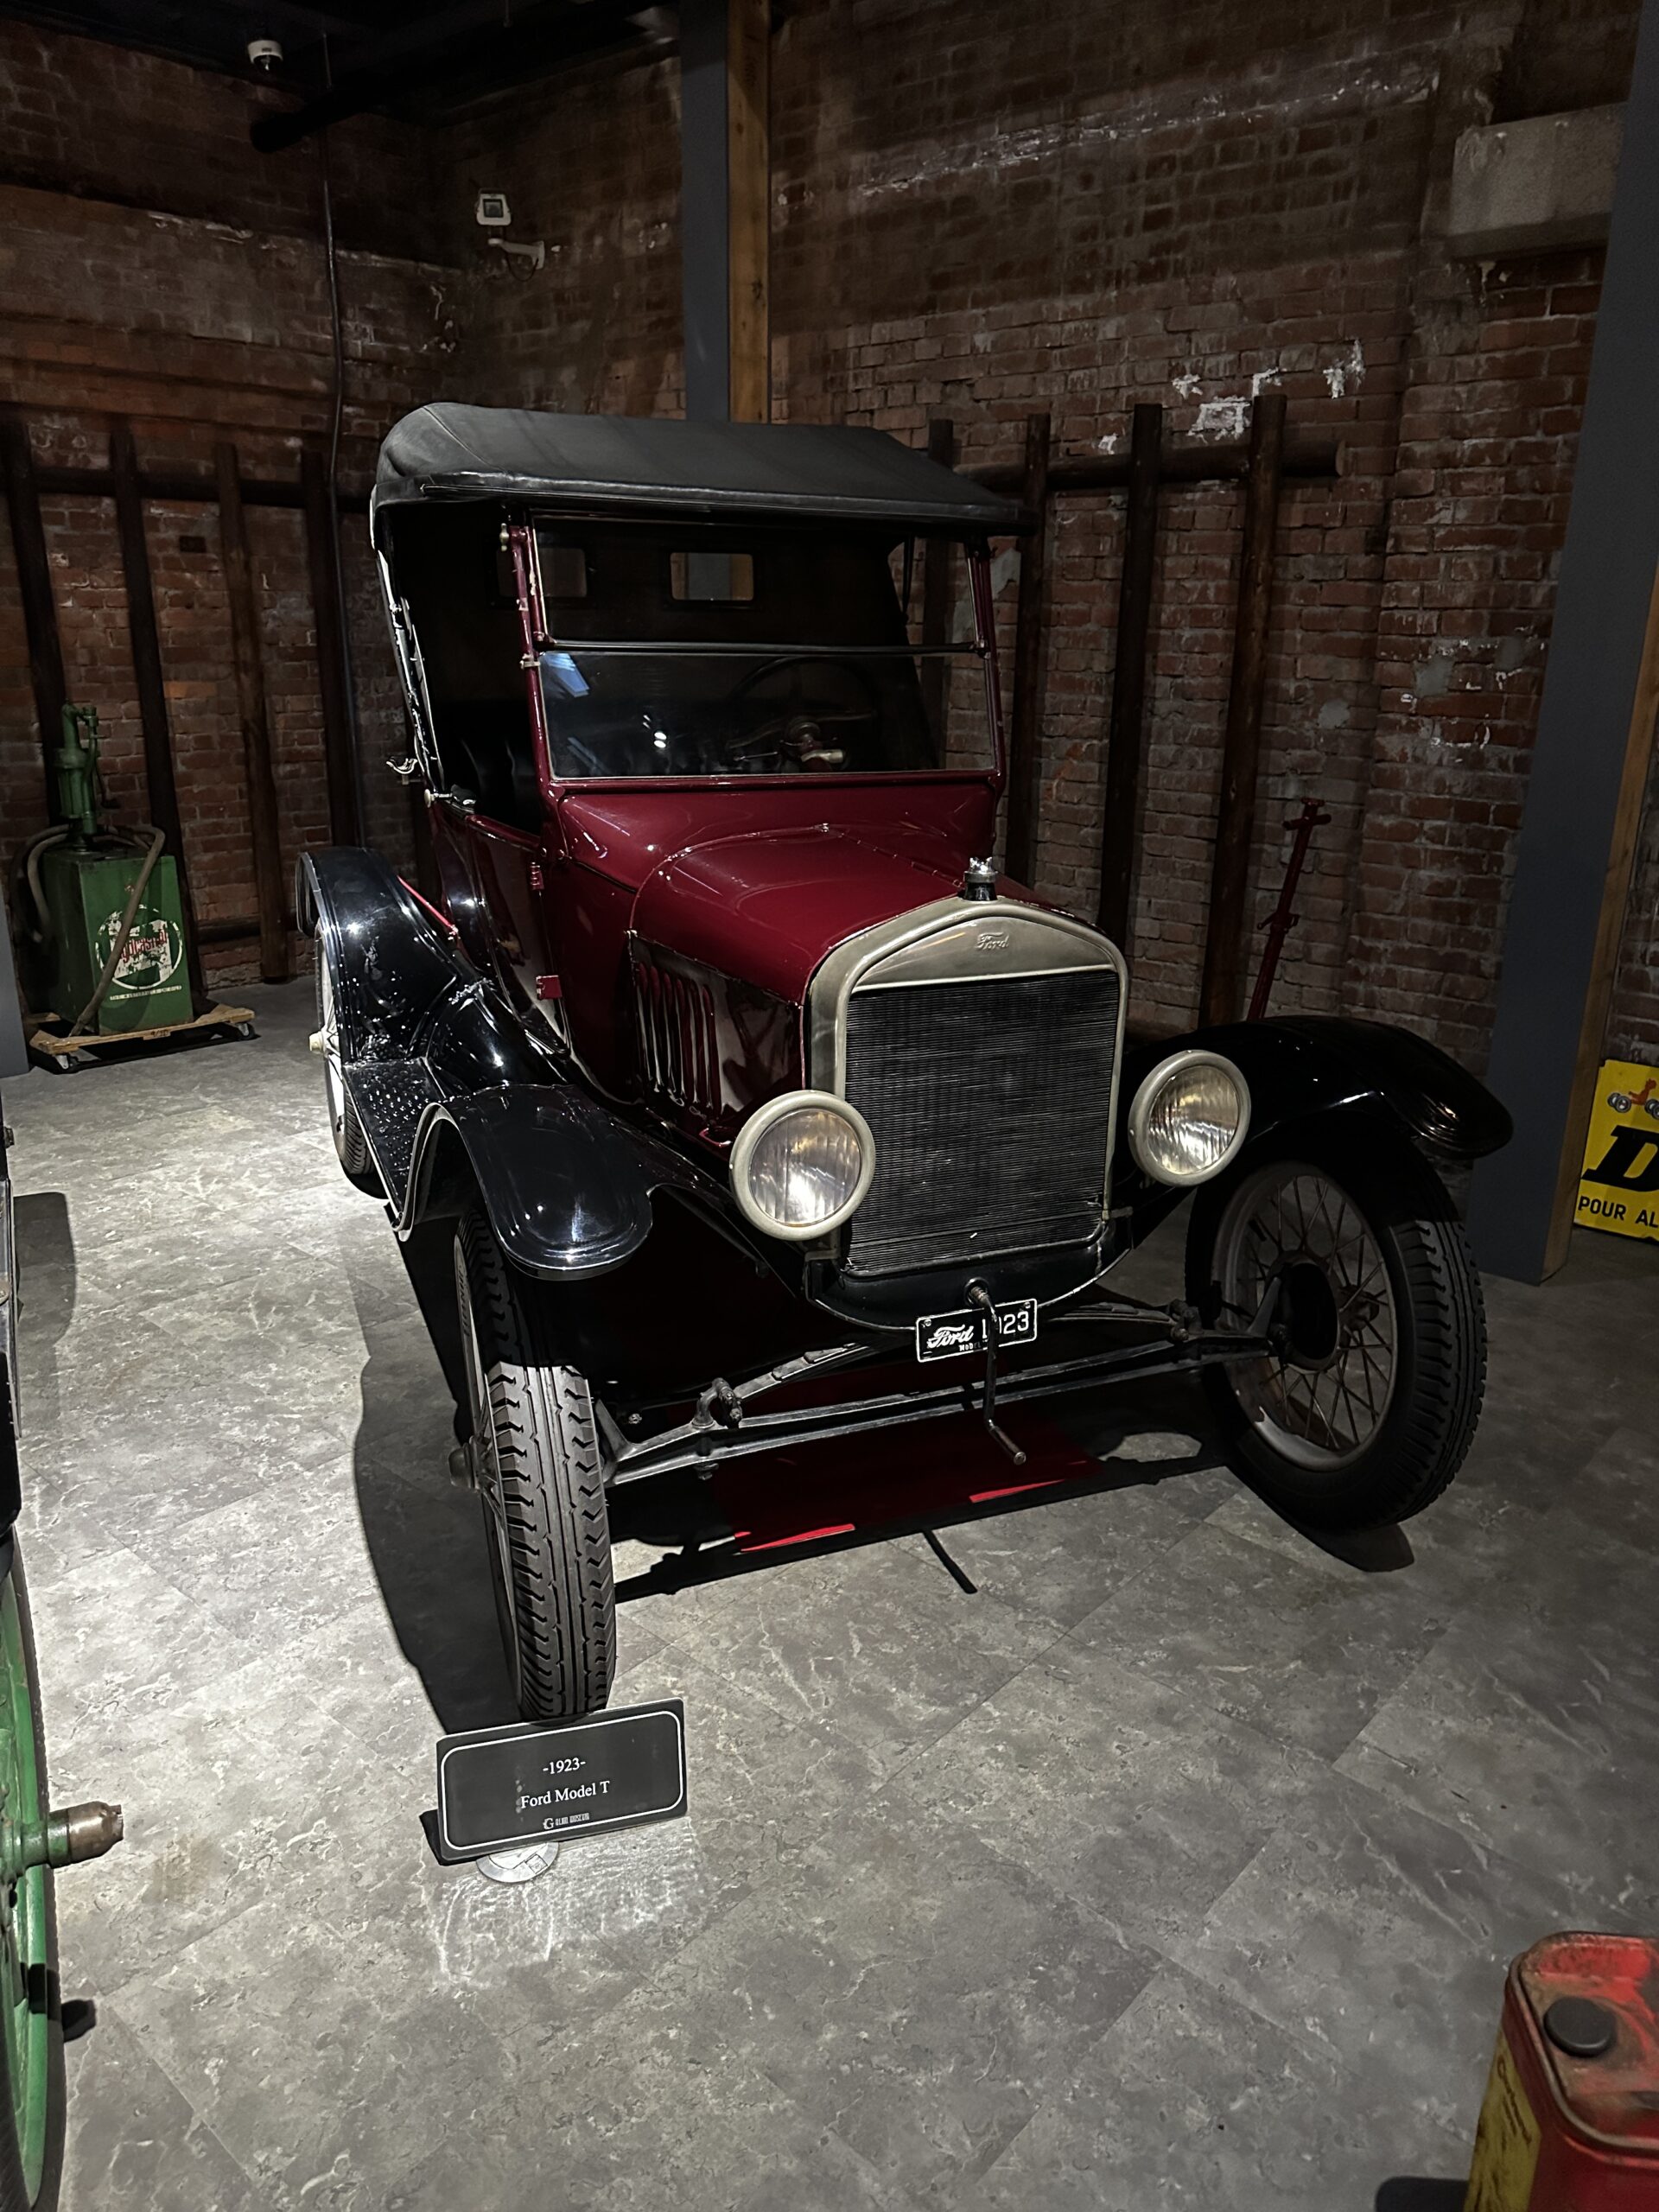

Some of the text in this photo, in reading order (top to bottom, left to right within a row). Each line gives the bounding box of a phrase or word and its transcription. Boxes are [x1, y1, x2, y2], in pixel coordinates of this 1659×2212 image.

[975, 932, 1009, 950] Ford
[1578, 1196, 1626, 1221] POUR
[926, 1311, 1029, 1349] Ford 123
[543, 1757, 586, 1774] -1923-
[520, 1780, 610, 1808] Ford Model T
